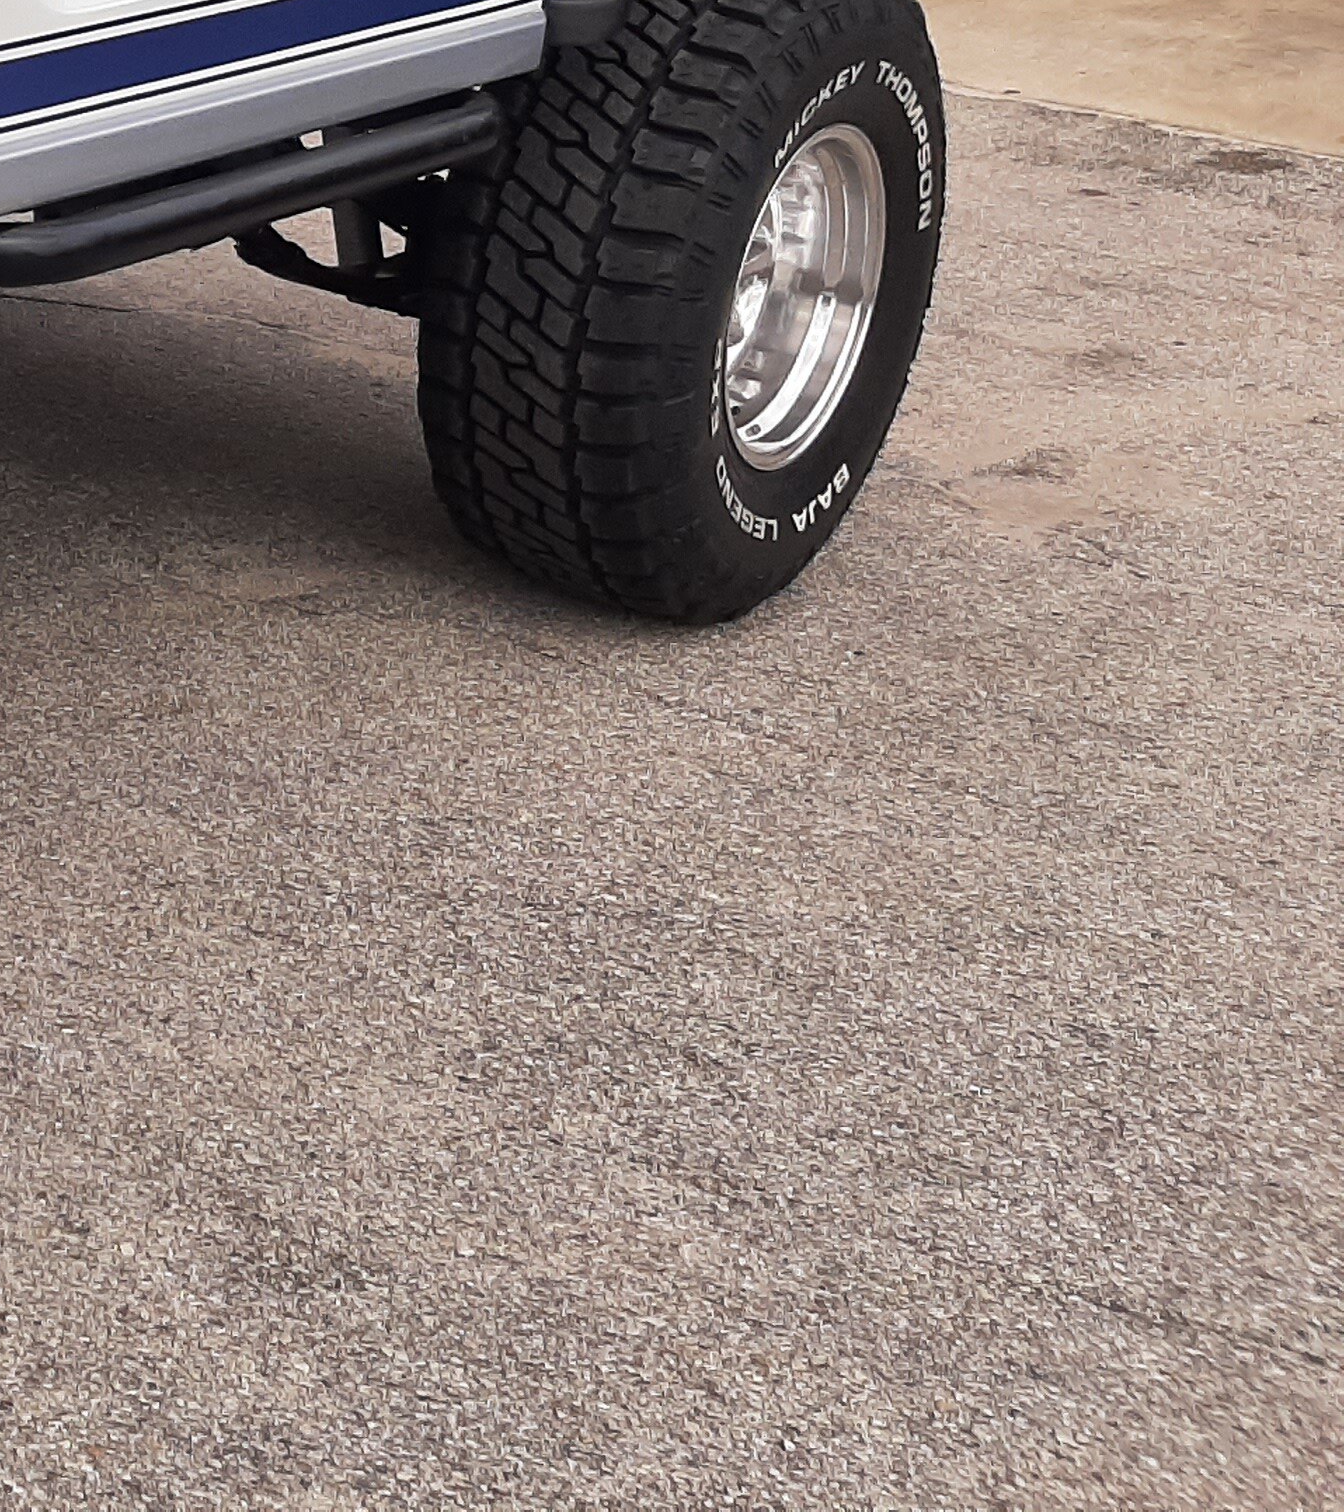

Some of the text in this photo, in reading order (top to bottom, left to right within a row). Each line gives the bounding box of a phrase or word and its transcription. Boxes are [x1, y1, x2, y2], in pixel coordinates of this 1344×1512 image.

[774, 59, 933, 232] MICKEY THOMPSON
[715, 454, 780, 542] LEGEND
[791, 462, 852, 533] BAJA
